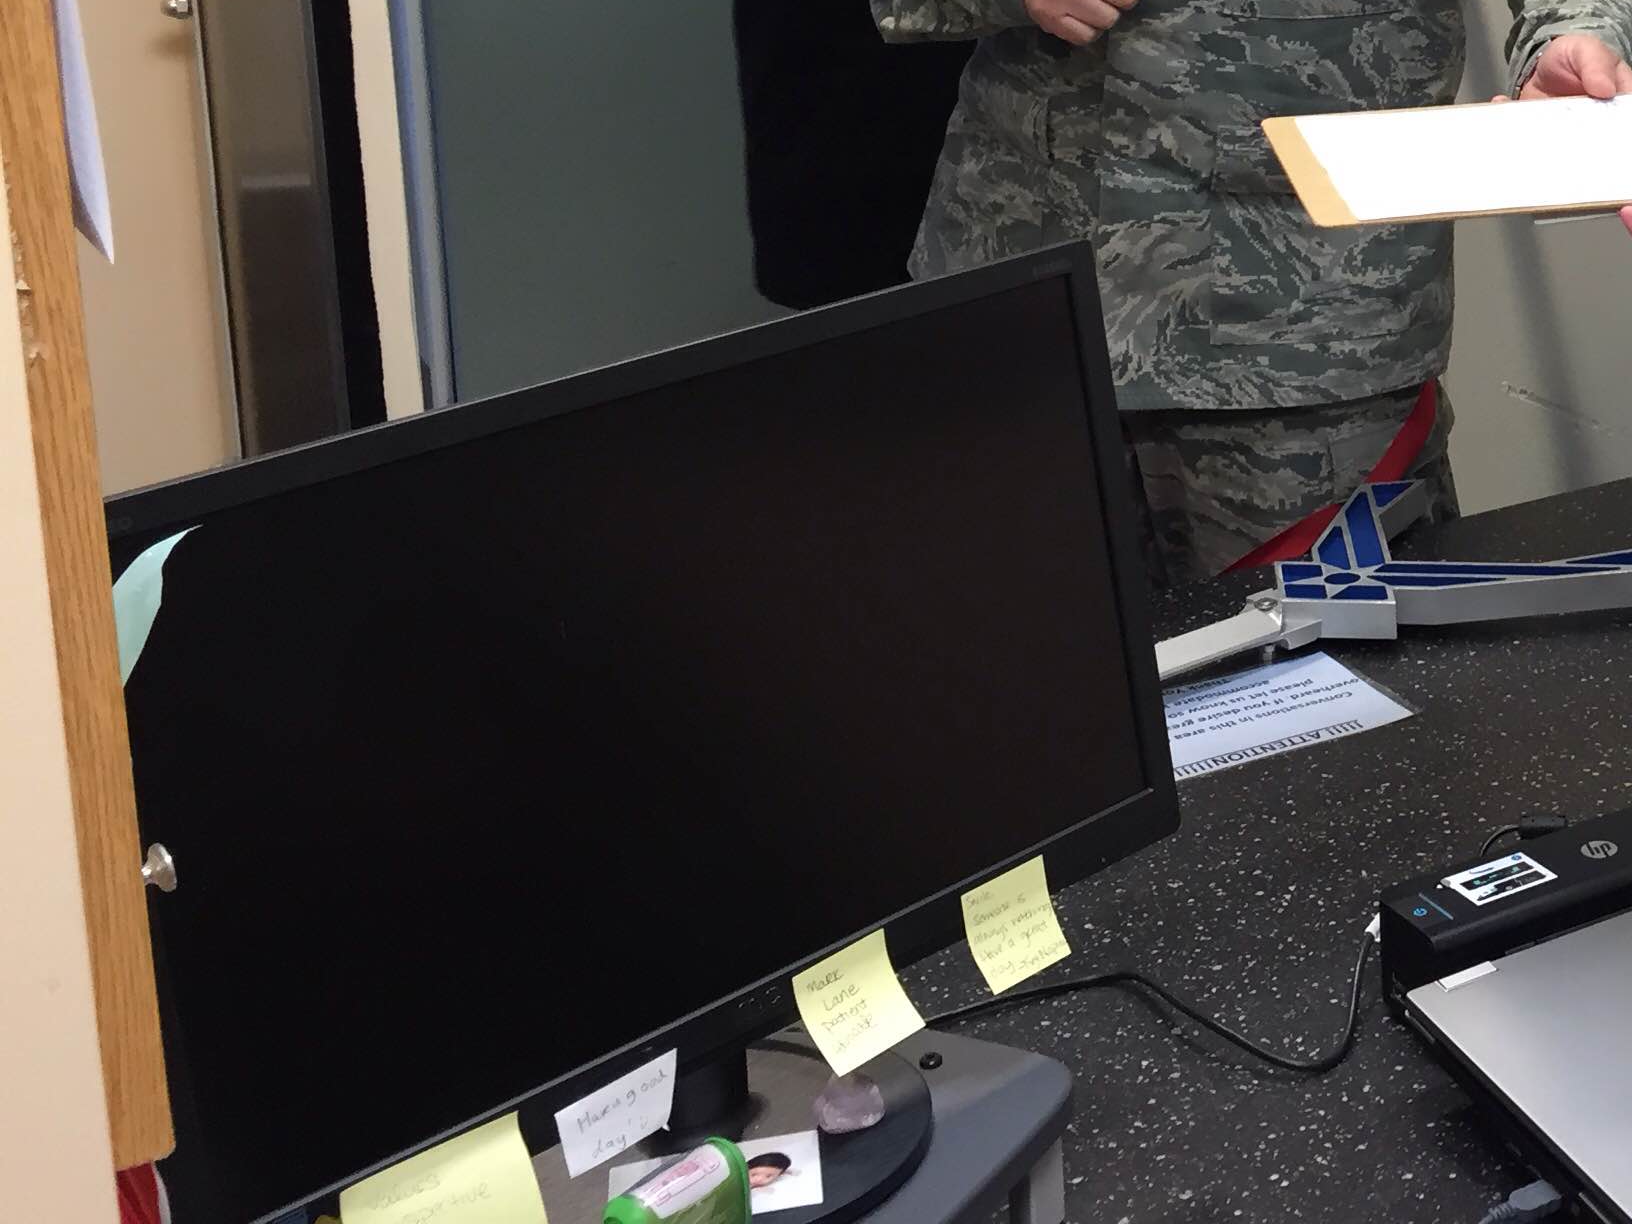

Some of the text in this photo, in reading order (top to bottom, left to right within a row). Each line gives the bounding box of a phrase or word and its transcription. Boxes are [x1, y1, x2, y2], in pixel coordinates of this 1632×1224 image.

[1167, 678, 1314, 719] please let us know so
[1243, 700, 1271, 711] you
[1174, 690, 1353, 740] Conversations in this area
[1197, 708, 1241, 723] desire
[1583, 840, 1614, 860] hp
